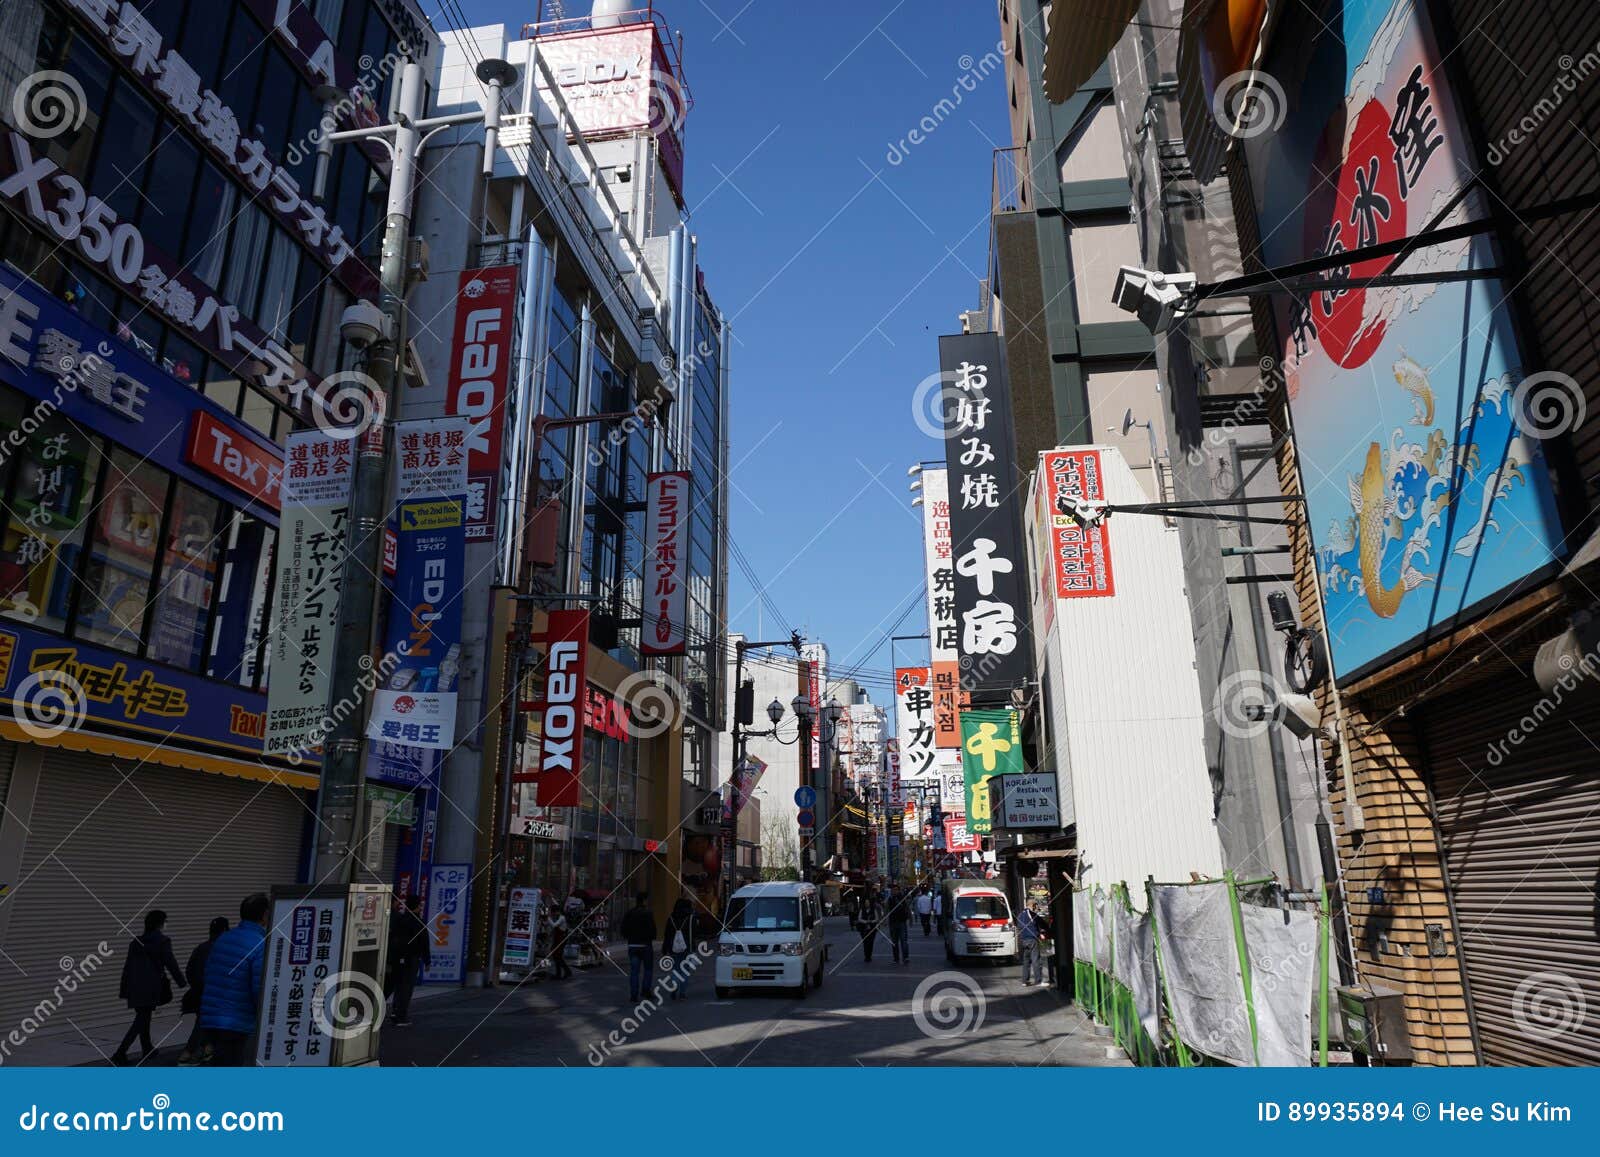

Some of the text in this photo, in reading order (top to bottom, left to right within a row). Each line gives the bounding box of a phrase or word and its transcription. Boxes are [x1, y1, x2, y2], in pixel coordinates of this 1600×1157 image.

[209, 427, 258, 487] Tax
[289, 439, 350, 461] 道頓堀
[401, 430, 464, 451] 道頓堀
[402, 448, 464, 469] 商店会
[955, 360, 1000, 511] お好み焼
[289, 457, 351, 479] 商店会
[656, 480, 678, 596] ドラゴンボウル
[932, 499, 952, 560] 逸品堂
[1060, 527, 1093, 591] 외화환전
[933, 566, 958, 651] 免税店
[956, 537, 1017, 656] 千房
[231, 705, 258, 737] Tax
[905, 686, 936, 777] 串カツ
[936, 671, 955, 733] 면세점
[1006, 777, 1038, 788] KOREAN
